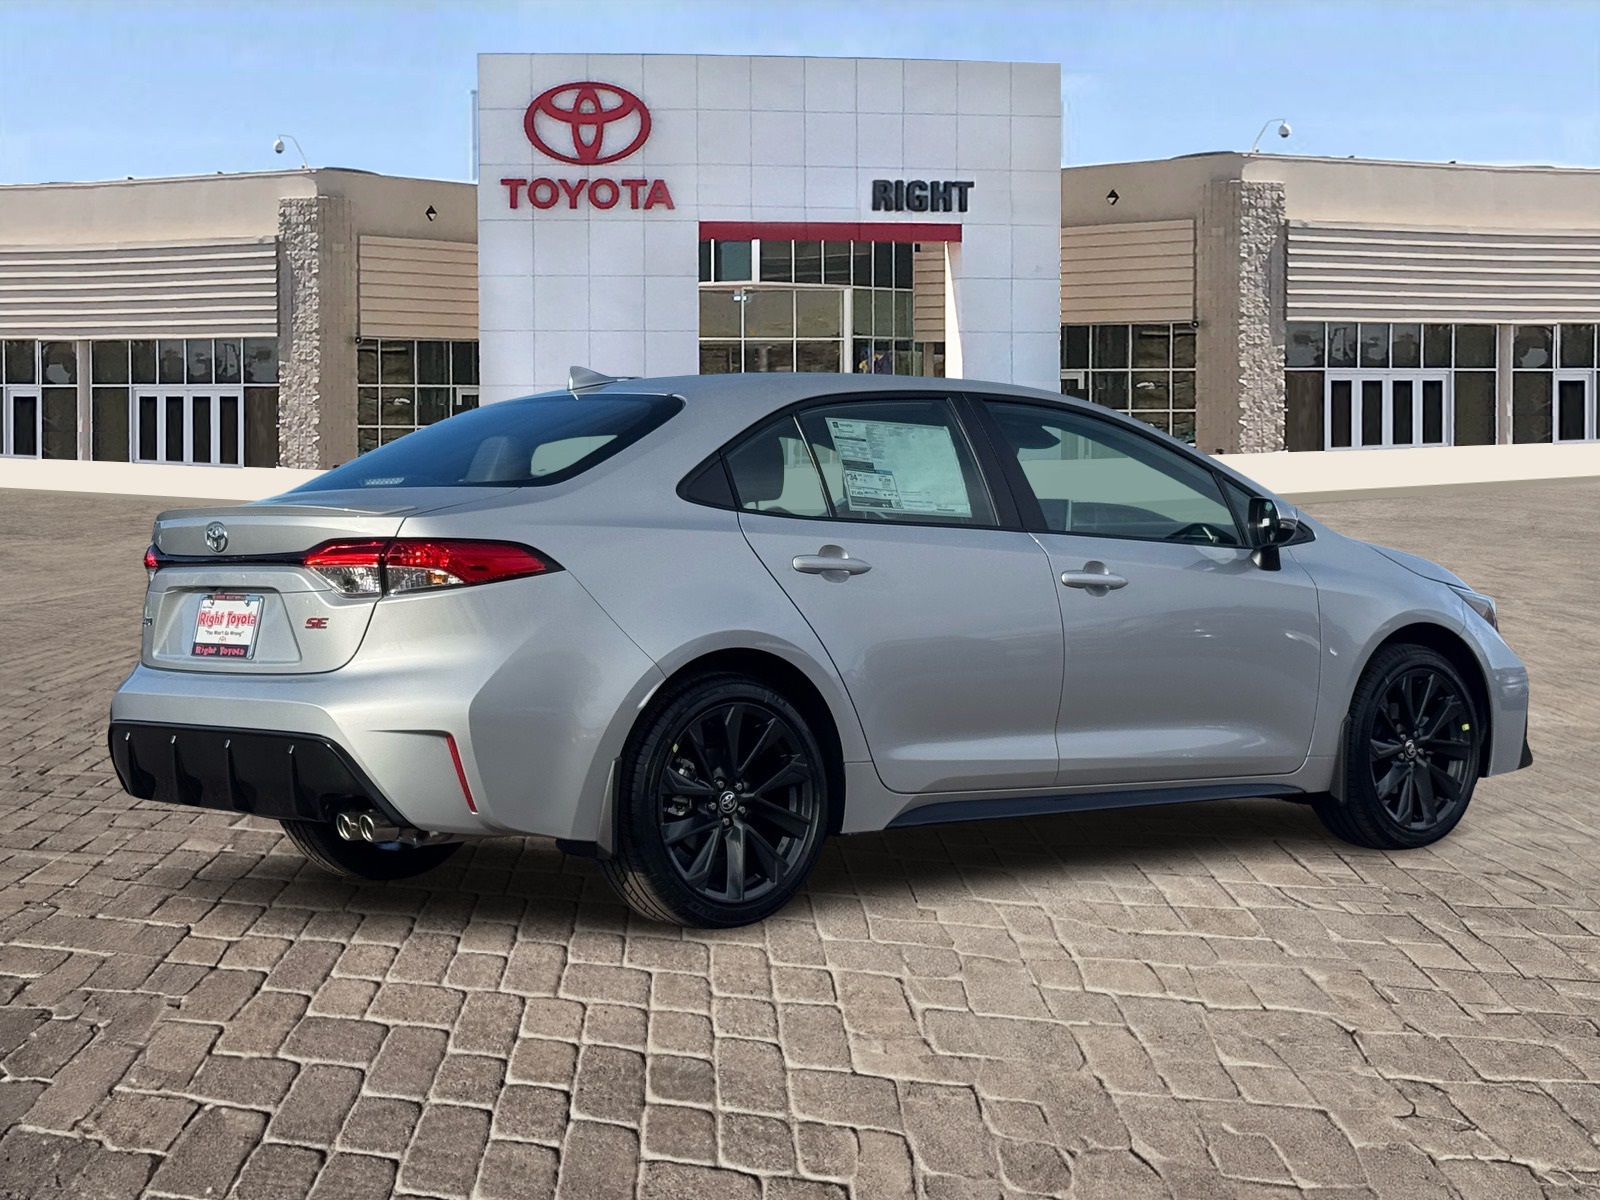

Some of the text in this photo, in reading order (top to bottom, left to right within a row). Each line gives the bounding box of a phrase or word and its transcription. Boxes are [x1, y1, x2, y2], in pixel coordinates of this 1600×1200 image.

[500, 179, 675, 211] TOYOTA
[871, 179, 975, 213] RIGHT
[199, 611, 256, 628] Right Toyota
[305, 618, 329, 629] SE
[195, 645, 245, 656] Right Toyota
